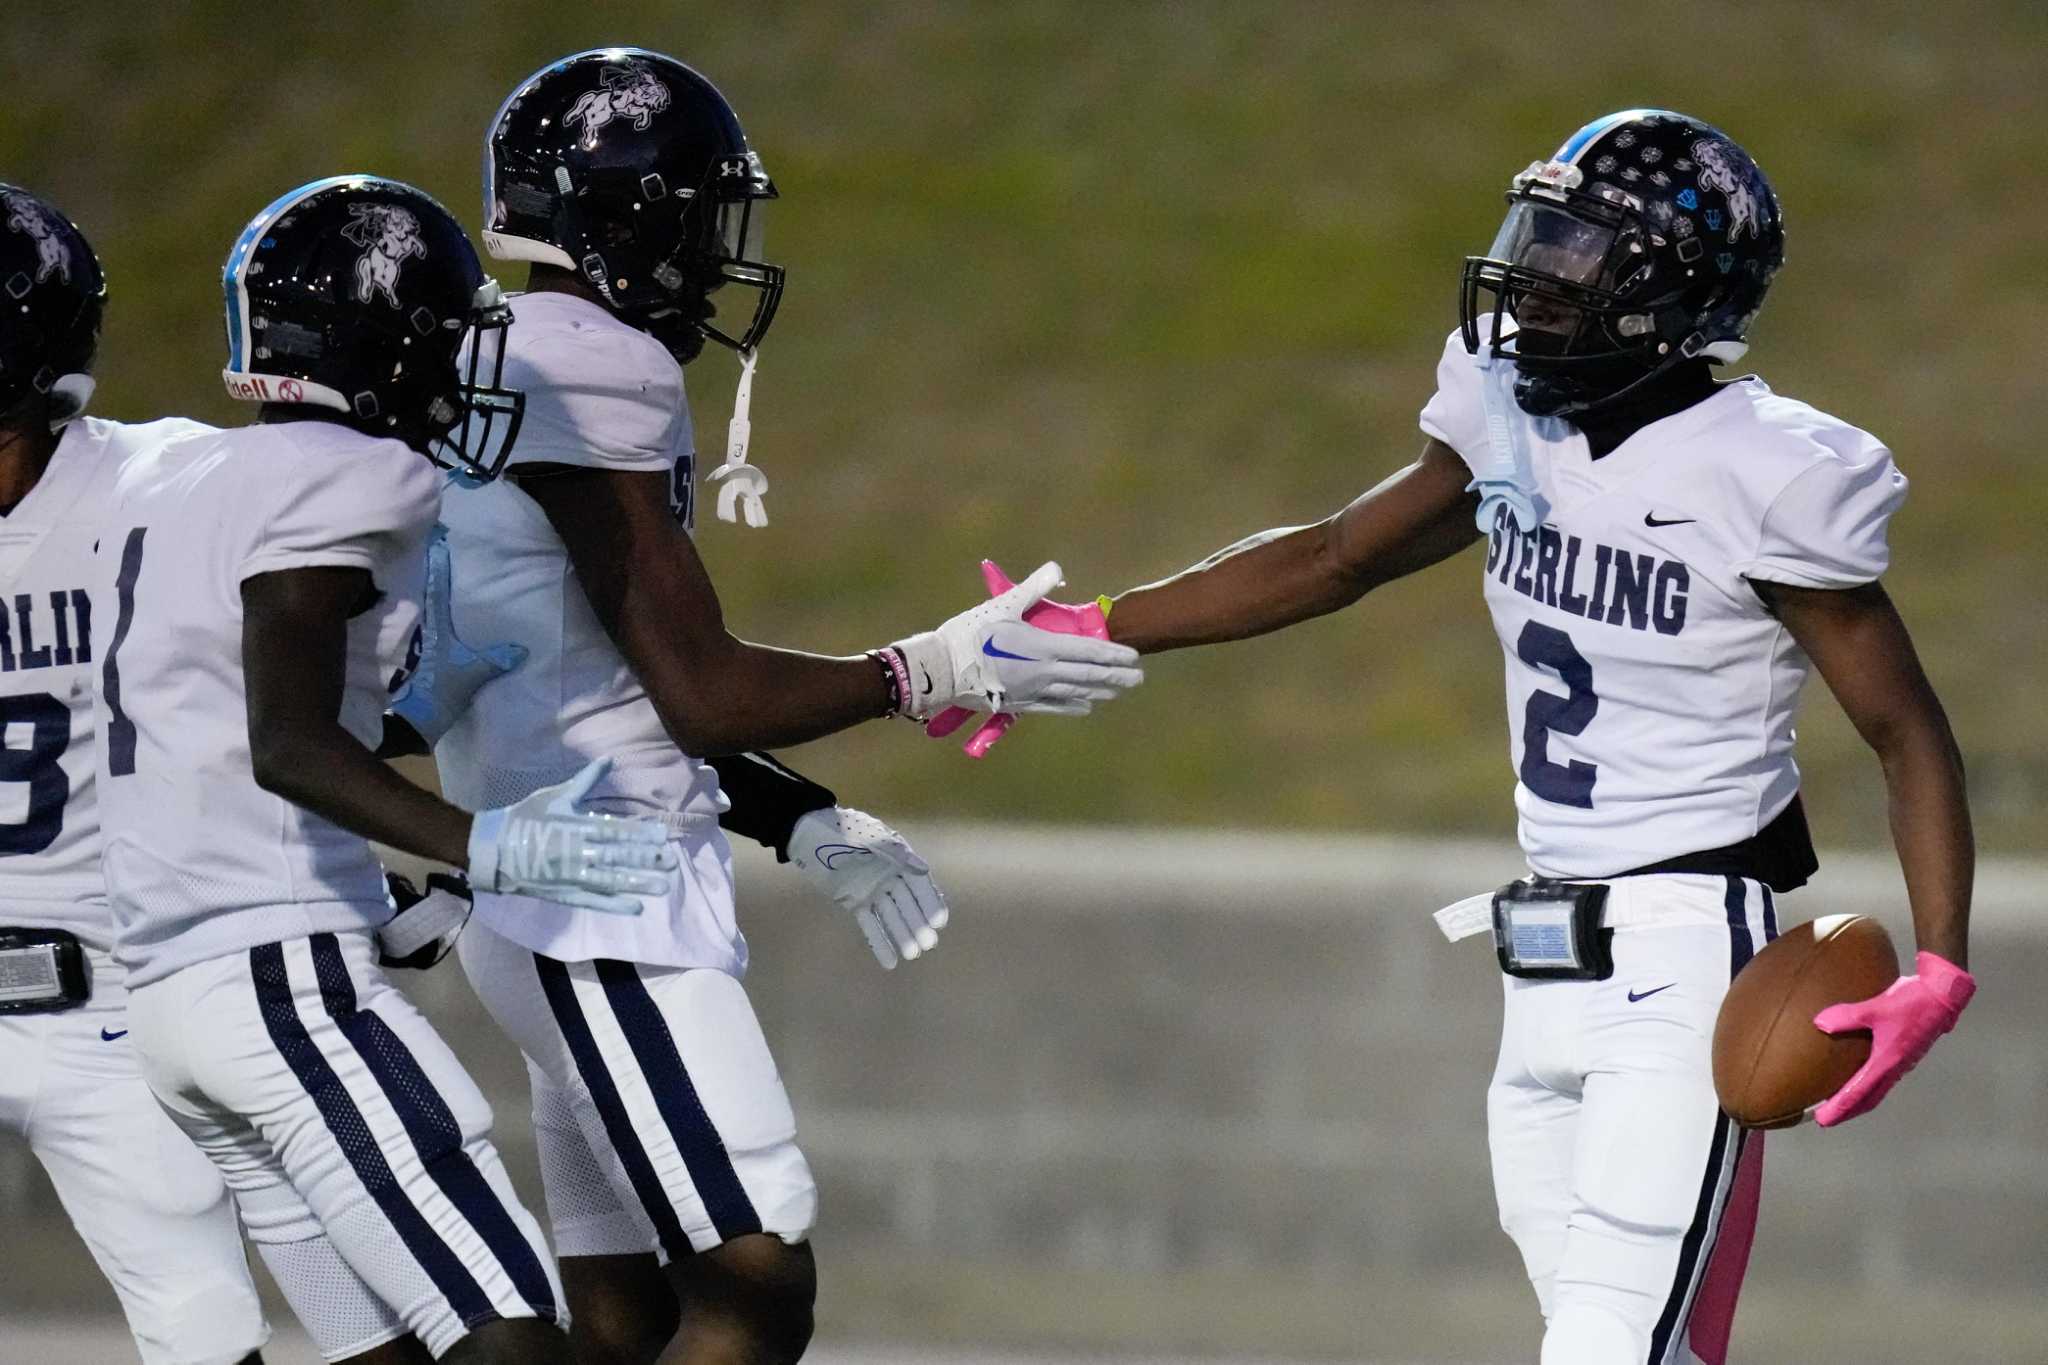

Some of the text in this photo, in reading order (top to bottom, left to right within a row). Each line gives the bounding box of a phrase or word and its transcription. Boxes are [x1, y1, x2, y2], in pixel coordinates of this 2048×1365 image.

[231, 378, 271, 399] dell
[1487, 502, 1690, 636] STERLING
[1517, 619, 1599, 809] 2
